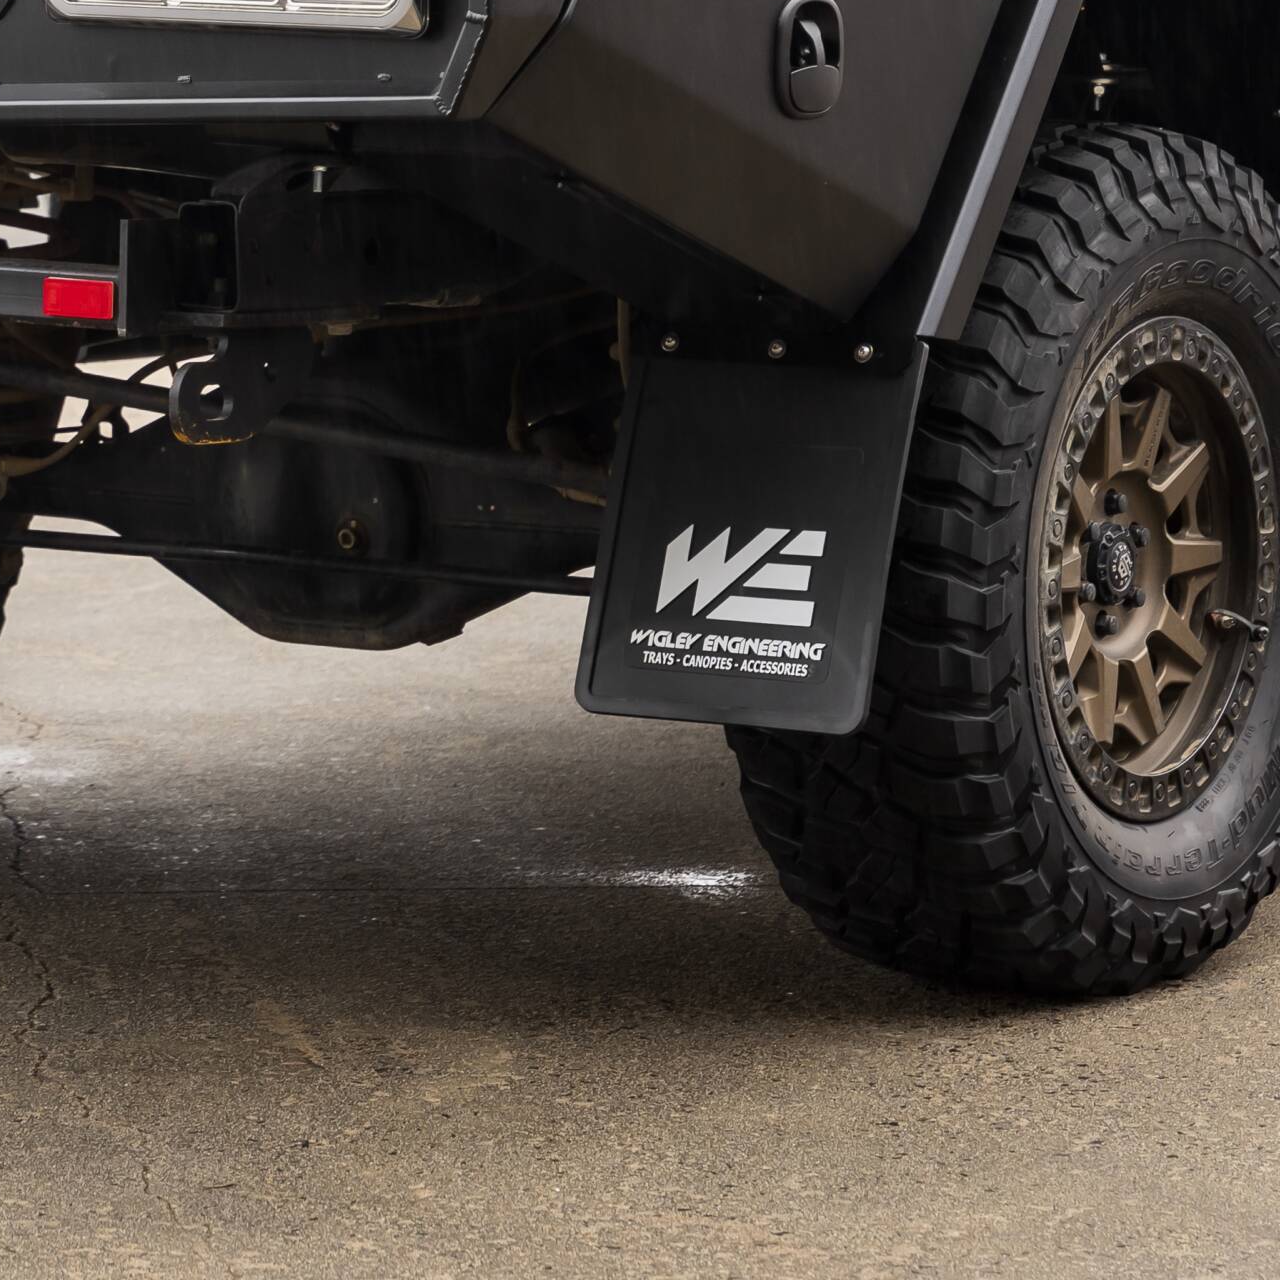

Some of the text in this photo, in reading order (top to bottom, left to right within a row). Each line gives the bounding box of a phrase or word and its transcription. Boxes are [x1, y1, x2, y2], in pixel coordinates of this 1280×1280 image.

[630, 628, 826, 661] WIGLEY ENGINEERING
[643, 650, 675, 665] TRAYS
[682, 654, 733, 670] CANOPIES
[740, 659, 808, 677] ACCESSORIES
